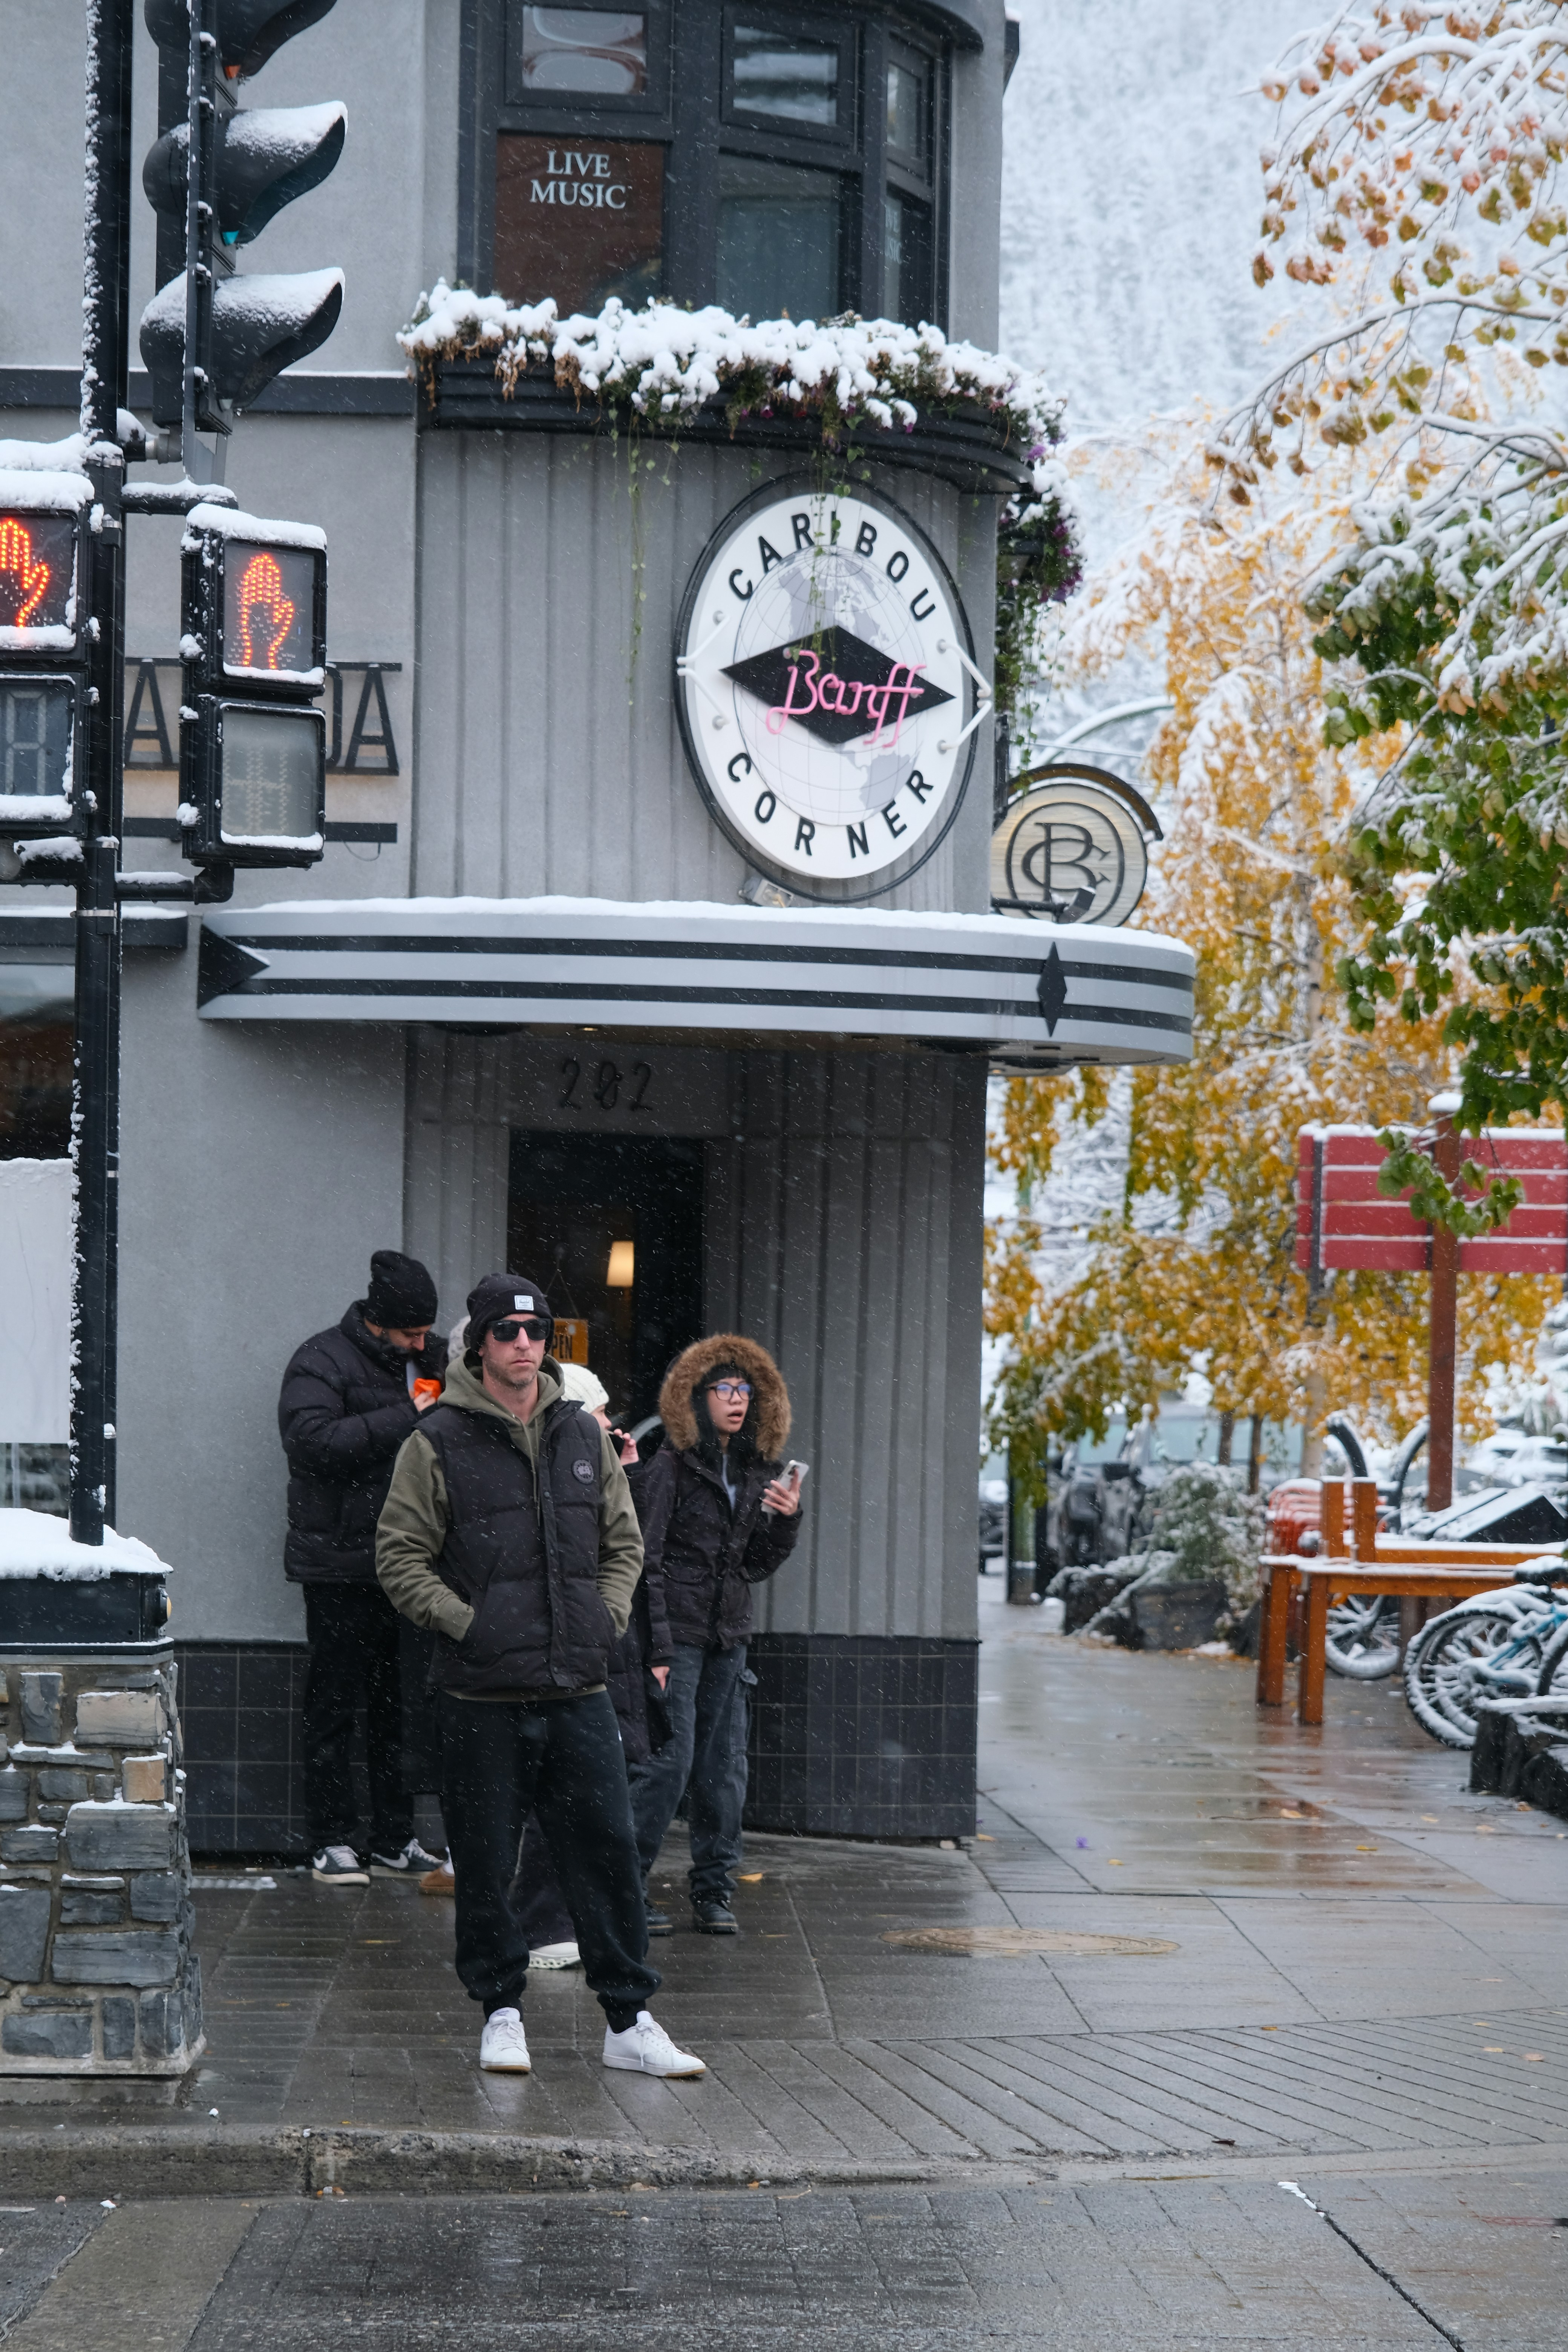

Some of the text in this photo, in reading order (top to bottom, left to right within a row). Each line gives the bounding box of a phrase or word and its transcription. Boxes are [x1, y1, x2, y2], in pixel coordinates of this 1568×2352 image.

[530, 180, 626, 209] MUSIC
[546, 150, 611, 178] LIVE
[729, 511, 936, 621] CARIBOU
[766, 649, 927, 748] Banff
[727, 752, 934, 858] CORNER
[552, 1334, 572, 1359] PEN
